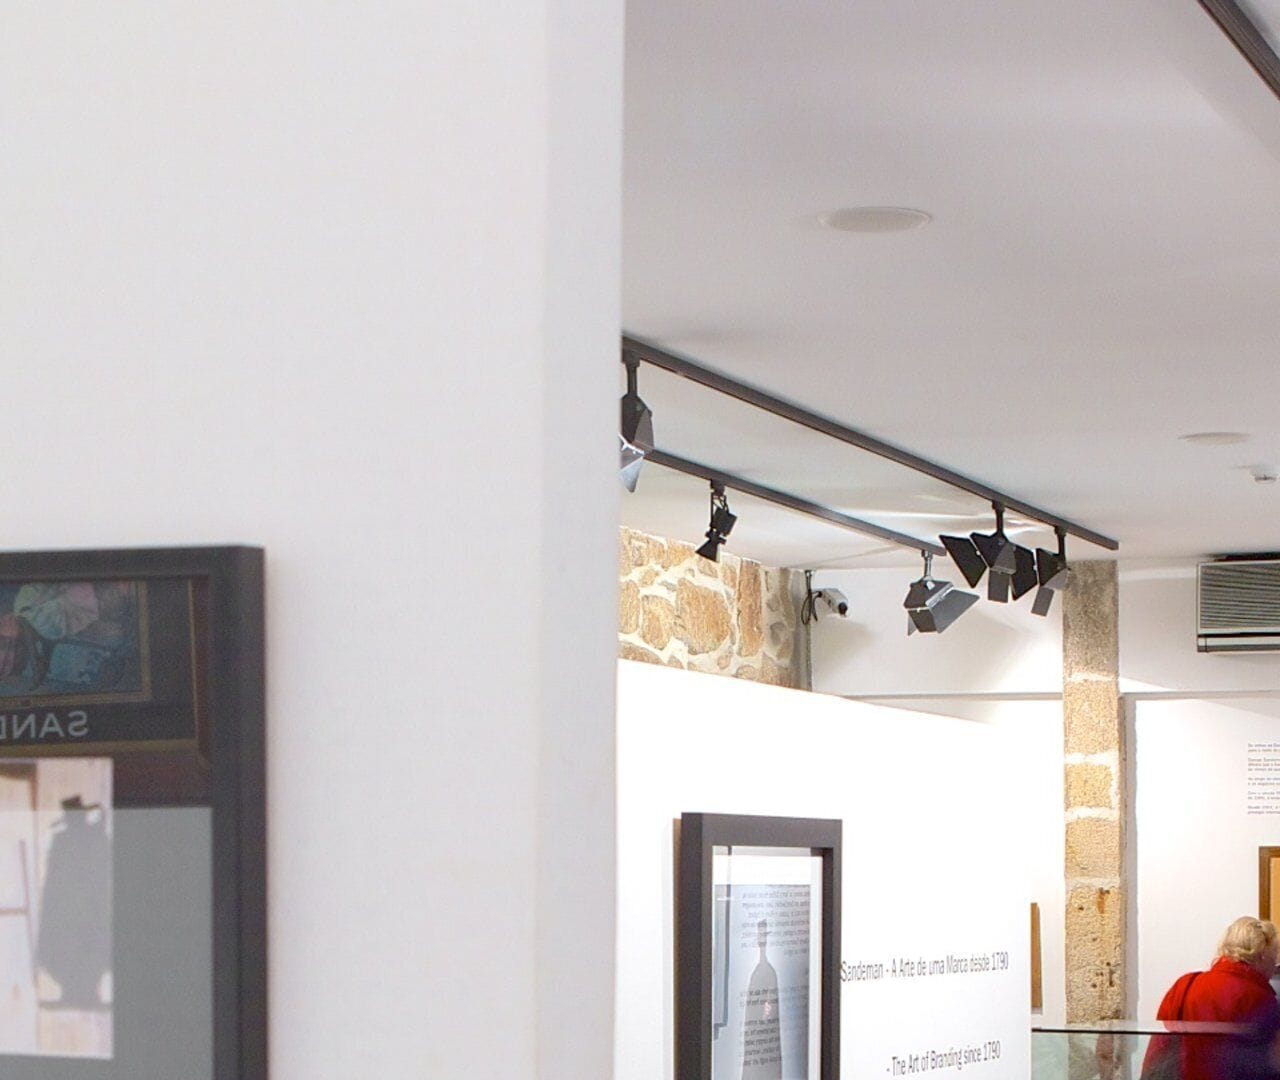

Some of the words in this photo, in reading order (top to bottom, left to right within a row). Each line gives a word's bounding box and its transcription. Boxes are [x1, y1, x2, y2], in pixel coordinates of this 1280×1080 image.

[917, 956, 927, 977] de
[892, 1055, 906, 1076] The
[907, 1053, 920, 1075] Art
[921, 1050, 930, 1072] of
